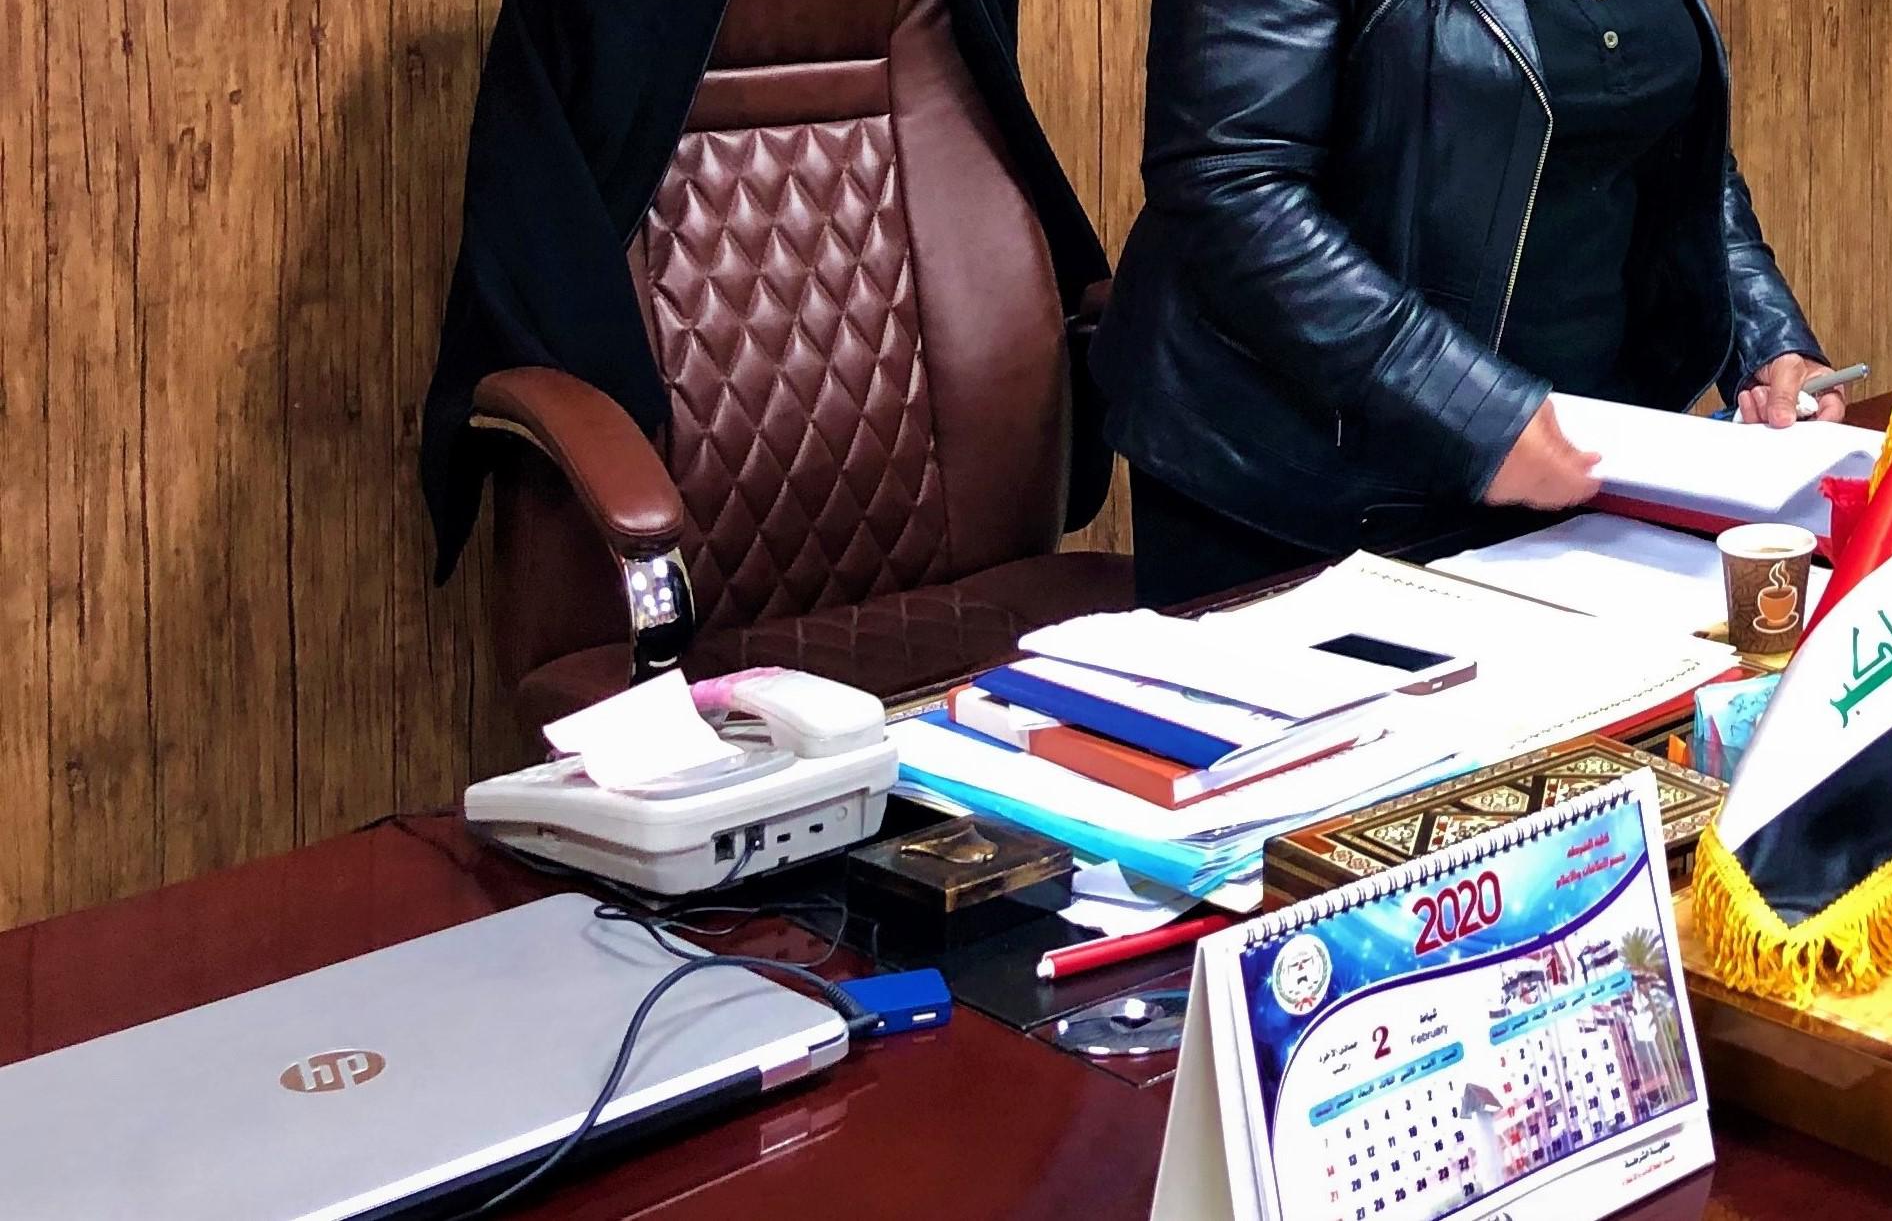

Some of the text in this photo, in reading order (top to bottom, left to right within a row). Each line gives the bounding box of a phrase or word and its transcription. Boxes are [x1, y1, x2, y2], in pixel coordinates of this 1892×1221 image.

[1411, 870, 1503, 956] 2020
[1372, 1026, 1391, 1060] 2
[1410, 1024, 1449, 1046] February
[290, 1050, 378, 1091] hp
